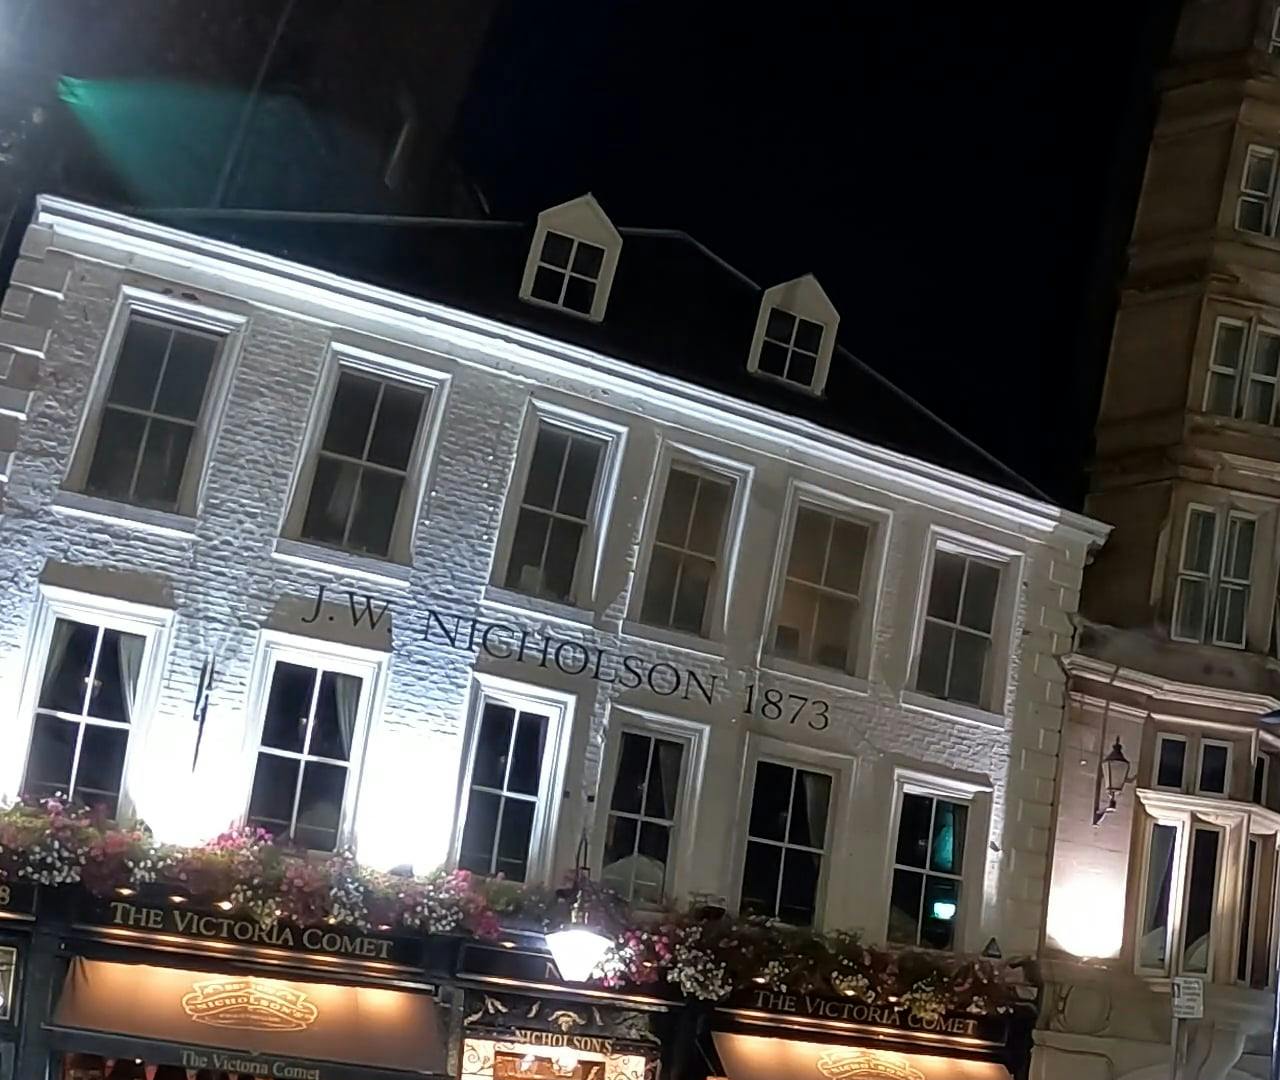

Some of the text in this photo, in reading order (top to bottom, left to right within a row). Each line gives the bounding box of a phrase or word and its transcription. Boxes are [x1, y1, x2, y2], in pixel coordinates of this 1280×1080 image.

[423, 609, 718, 704] NICHOLSON
[742, 684, 829, 730] 1873
[110, 902, 394, 958] THE VICTORIA COMET
[754, 990, 978, 1035] THE VICTORIA COMET
[181, 1050, 320, 1080] The Victoria Comet
